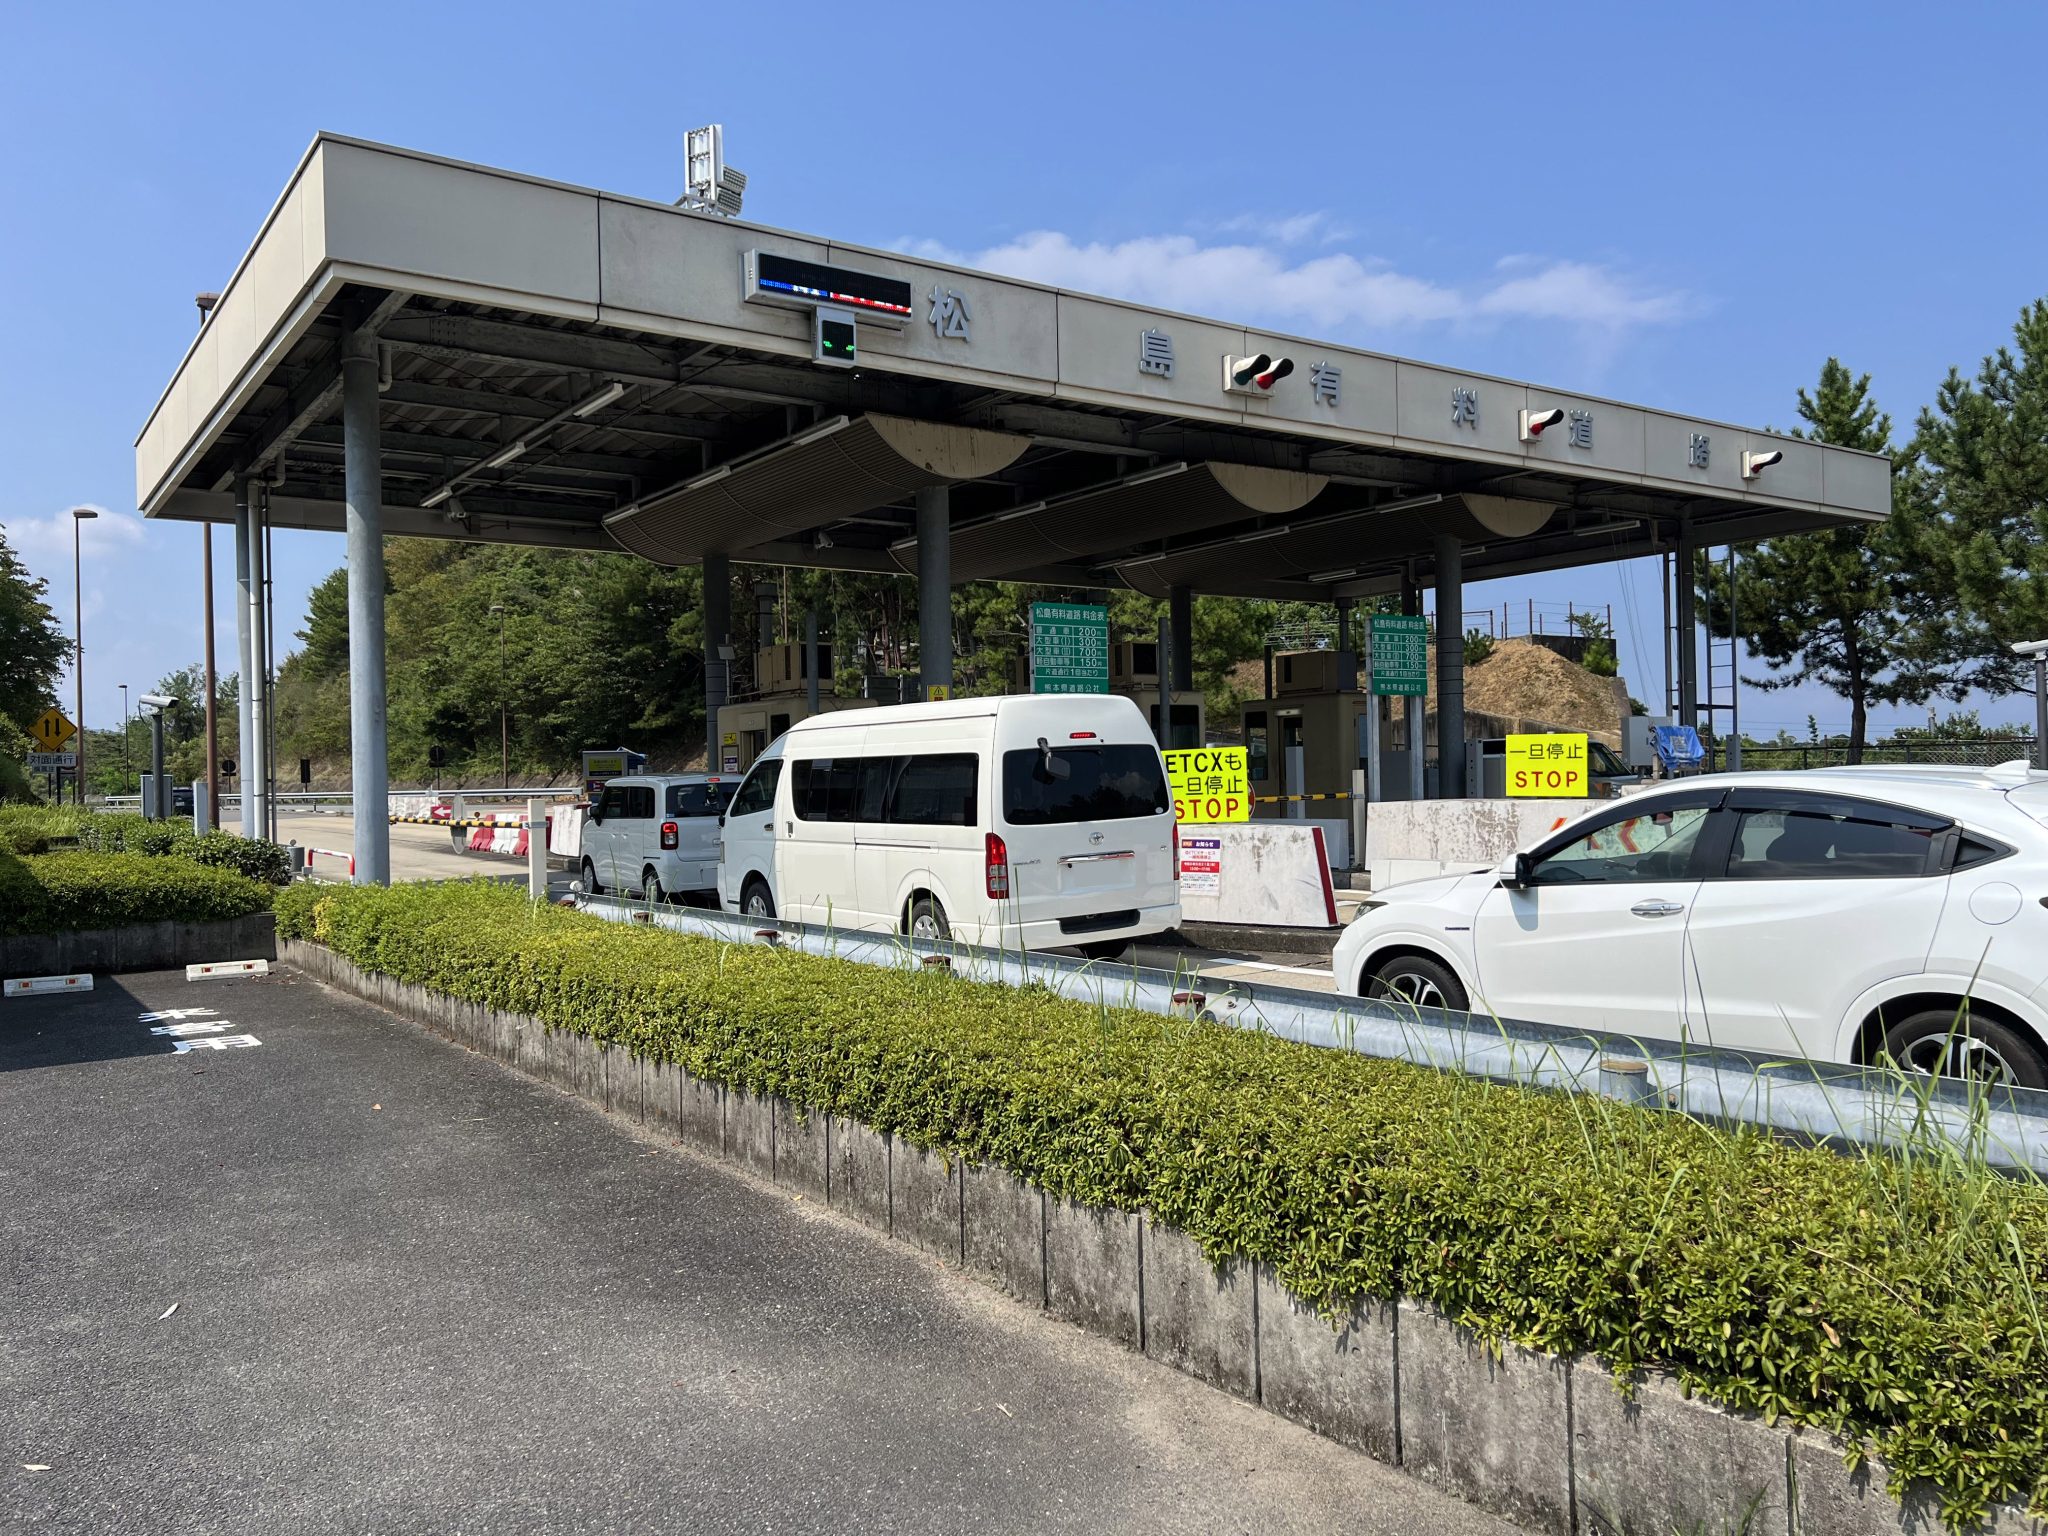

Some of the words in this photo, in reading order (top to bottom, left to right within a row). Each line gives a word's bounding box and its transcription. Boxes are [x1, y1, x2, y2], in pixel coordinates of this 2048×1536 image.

[1036, 608, 1081, 620] 松島有料道路
[1082, 610, 1105, 621] 料金表
[1374, 619, 1408, 629] 松島有料道路
[1044, 684, 1100, 692] 熊本県道路公社
[30, 754, 73, 765] 対面通行
[1509, 743, 1583, 760] 一旦停止
[1165, 752, 1242, 774] ETCXも
[1171, 775, 1243, 795] 一旦停止
[1515, 770, 1578, 788] STOP
[1174, 798, 1239, 819] STOP
